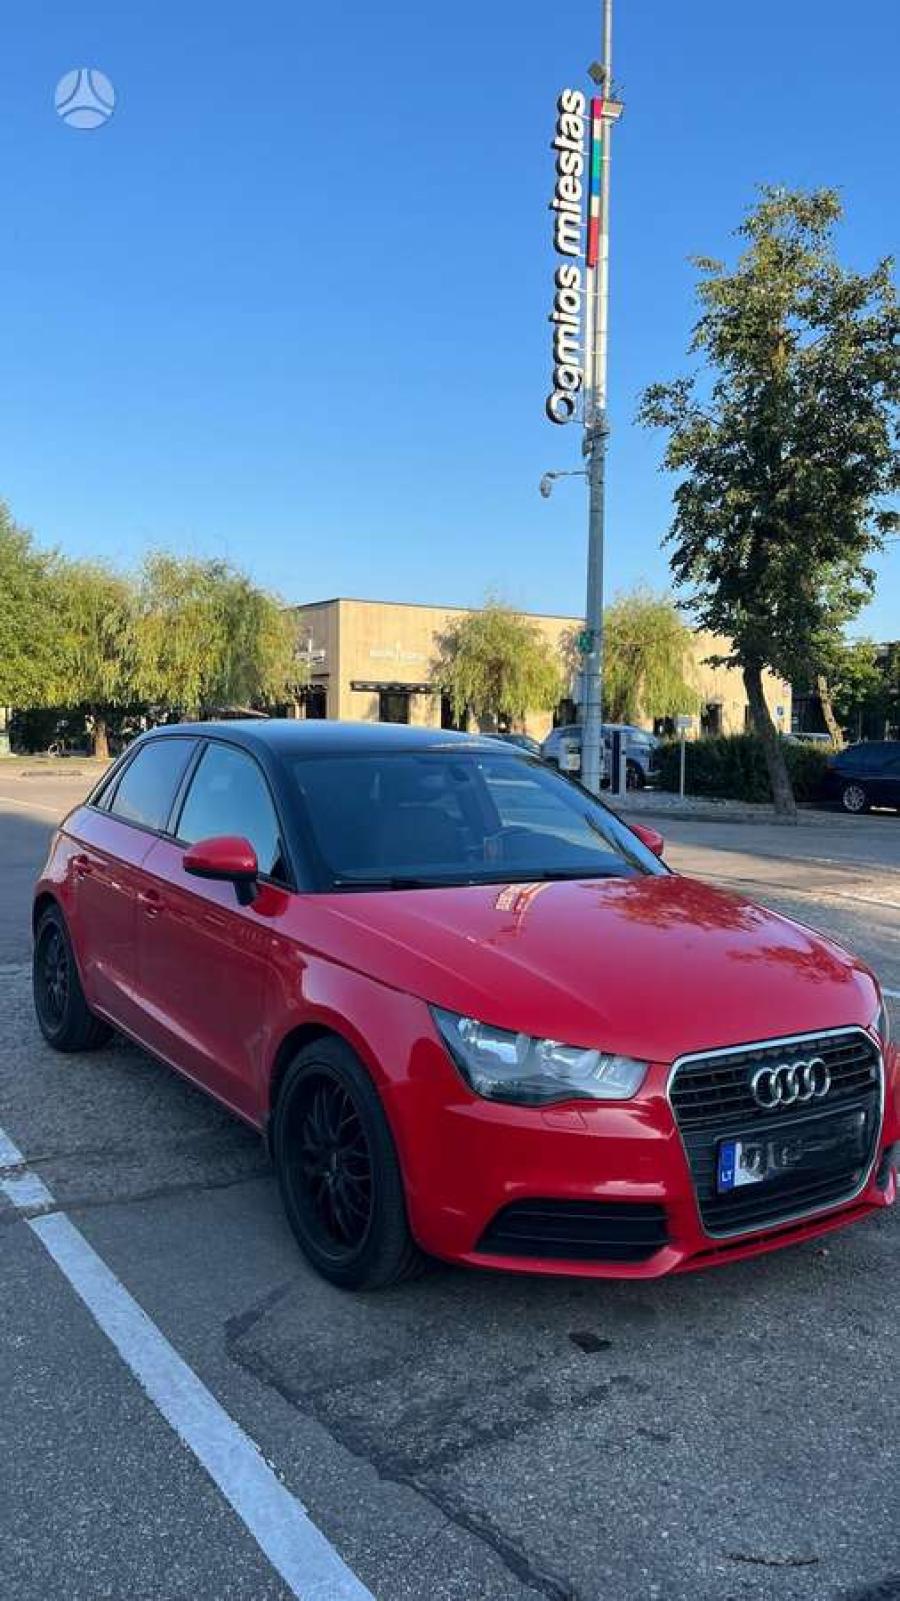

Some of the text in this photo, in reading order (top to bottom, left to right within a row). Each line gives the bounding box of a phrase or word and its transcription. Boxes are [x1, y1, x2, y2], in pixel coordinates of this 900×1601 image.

[546, 88, 586, 424] Ogmios miestas
[722, 1170, 732, 1182] LT
